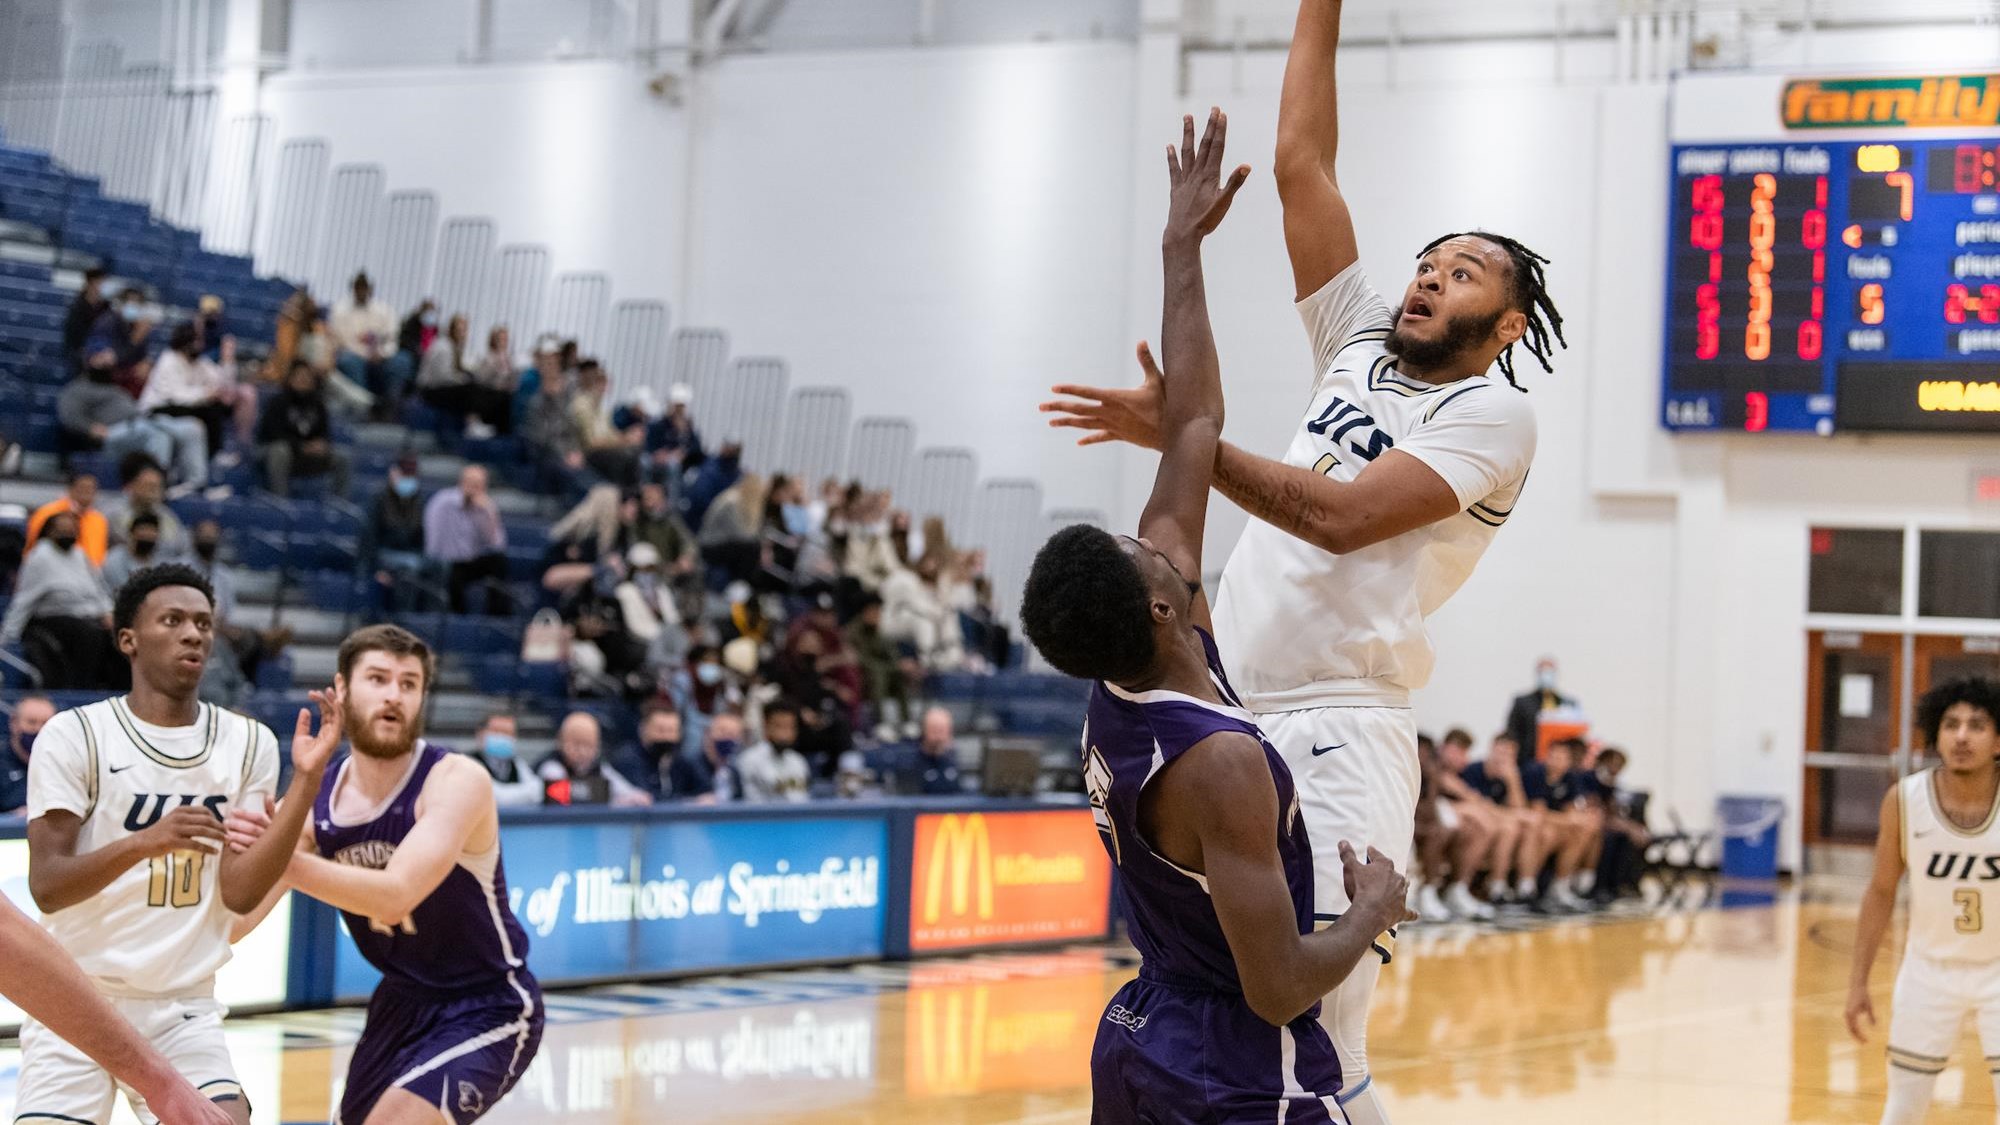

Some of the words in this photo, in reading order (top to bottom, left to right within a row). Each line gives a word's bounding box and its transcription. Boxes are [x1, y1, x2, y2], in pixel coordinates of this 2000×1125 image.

[1786, 76, 2000, 127] family
[1802, 210, 1827, 250] 0
[1860, 284, 1884, 324] 5
[1745, 322, 1771, 360] 0
[1797, 320, 1822, 360] 0
[1307, 396, 1394, 462] UIS
[526, 870, 571, 938] of
[574, 864, 690, 924] Illinois
[691, 872, 725, 916] at
[727, 855, 879, 928] Springfield
[1953, 887, 1983, 933] 3
